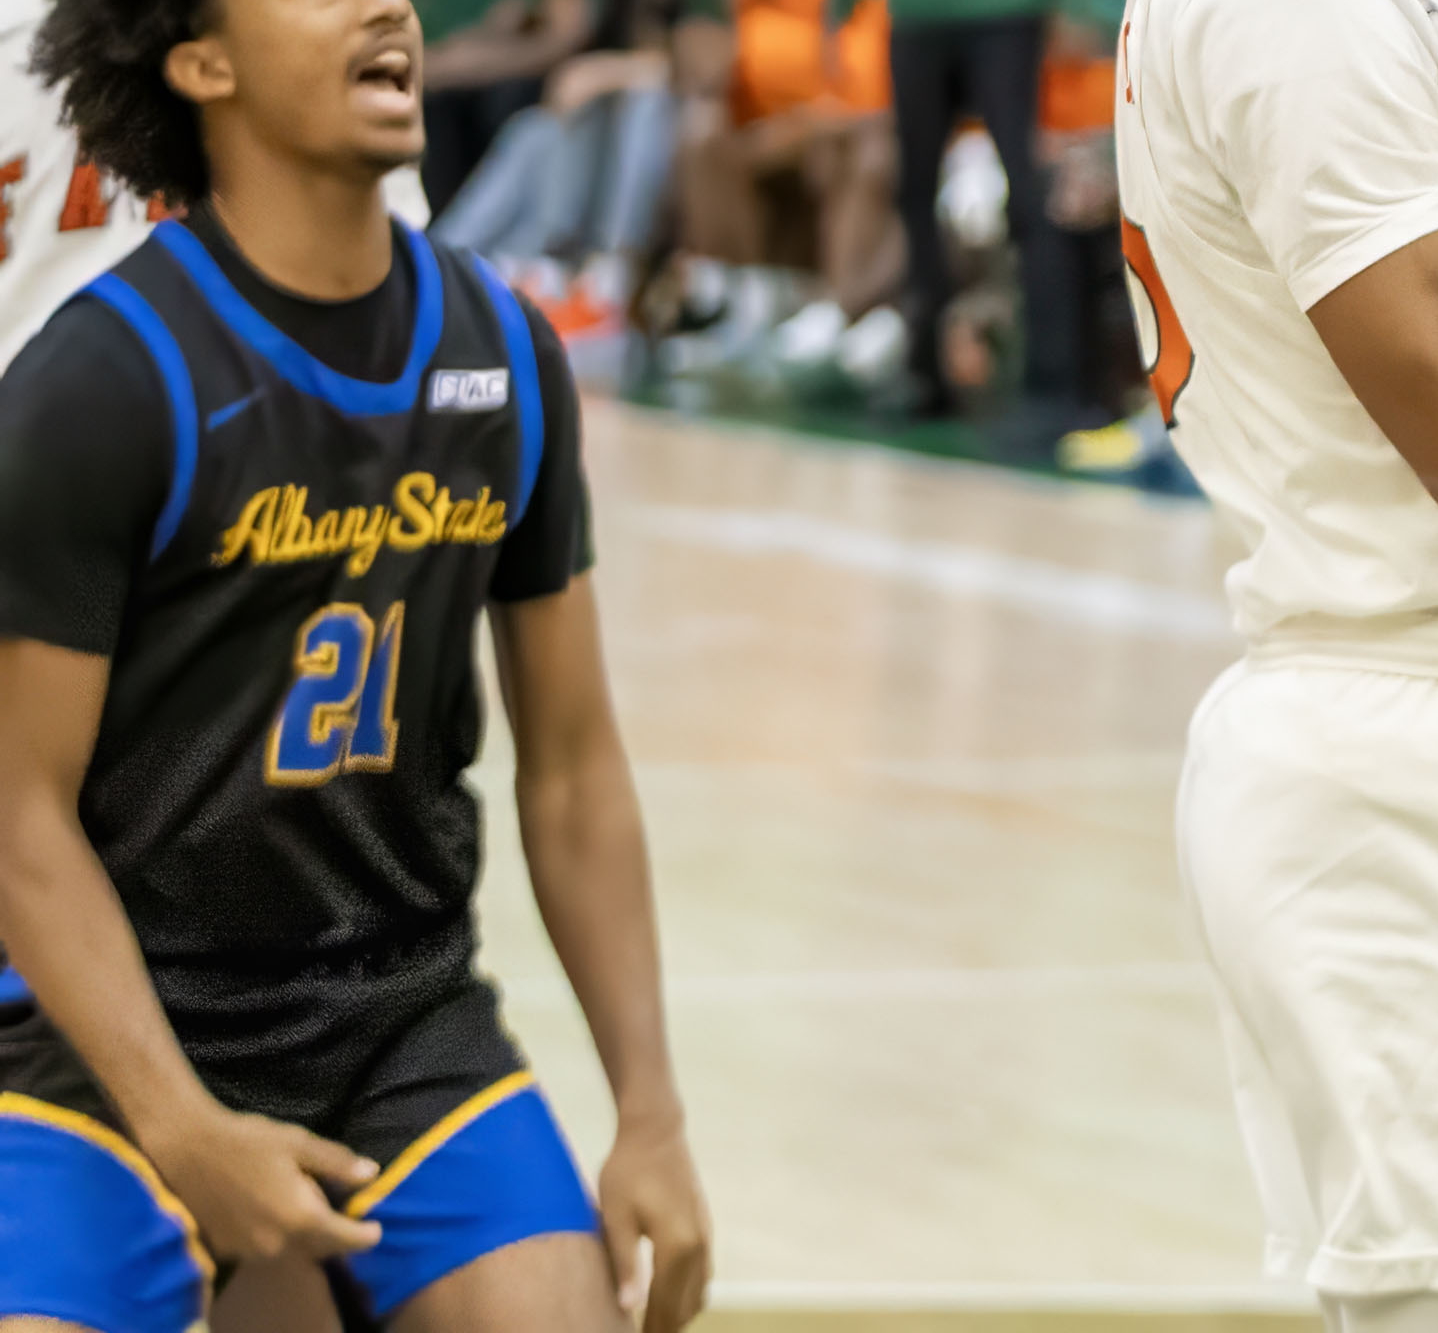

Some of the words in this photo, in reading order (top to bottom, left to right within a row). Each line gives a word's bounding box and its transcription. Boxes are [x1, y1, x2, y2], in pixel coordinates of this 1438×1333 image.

[211, 484, 388, 577] Albany
[386, 472, 508, 550] State
[265, 600, 405, 786] 21
